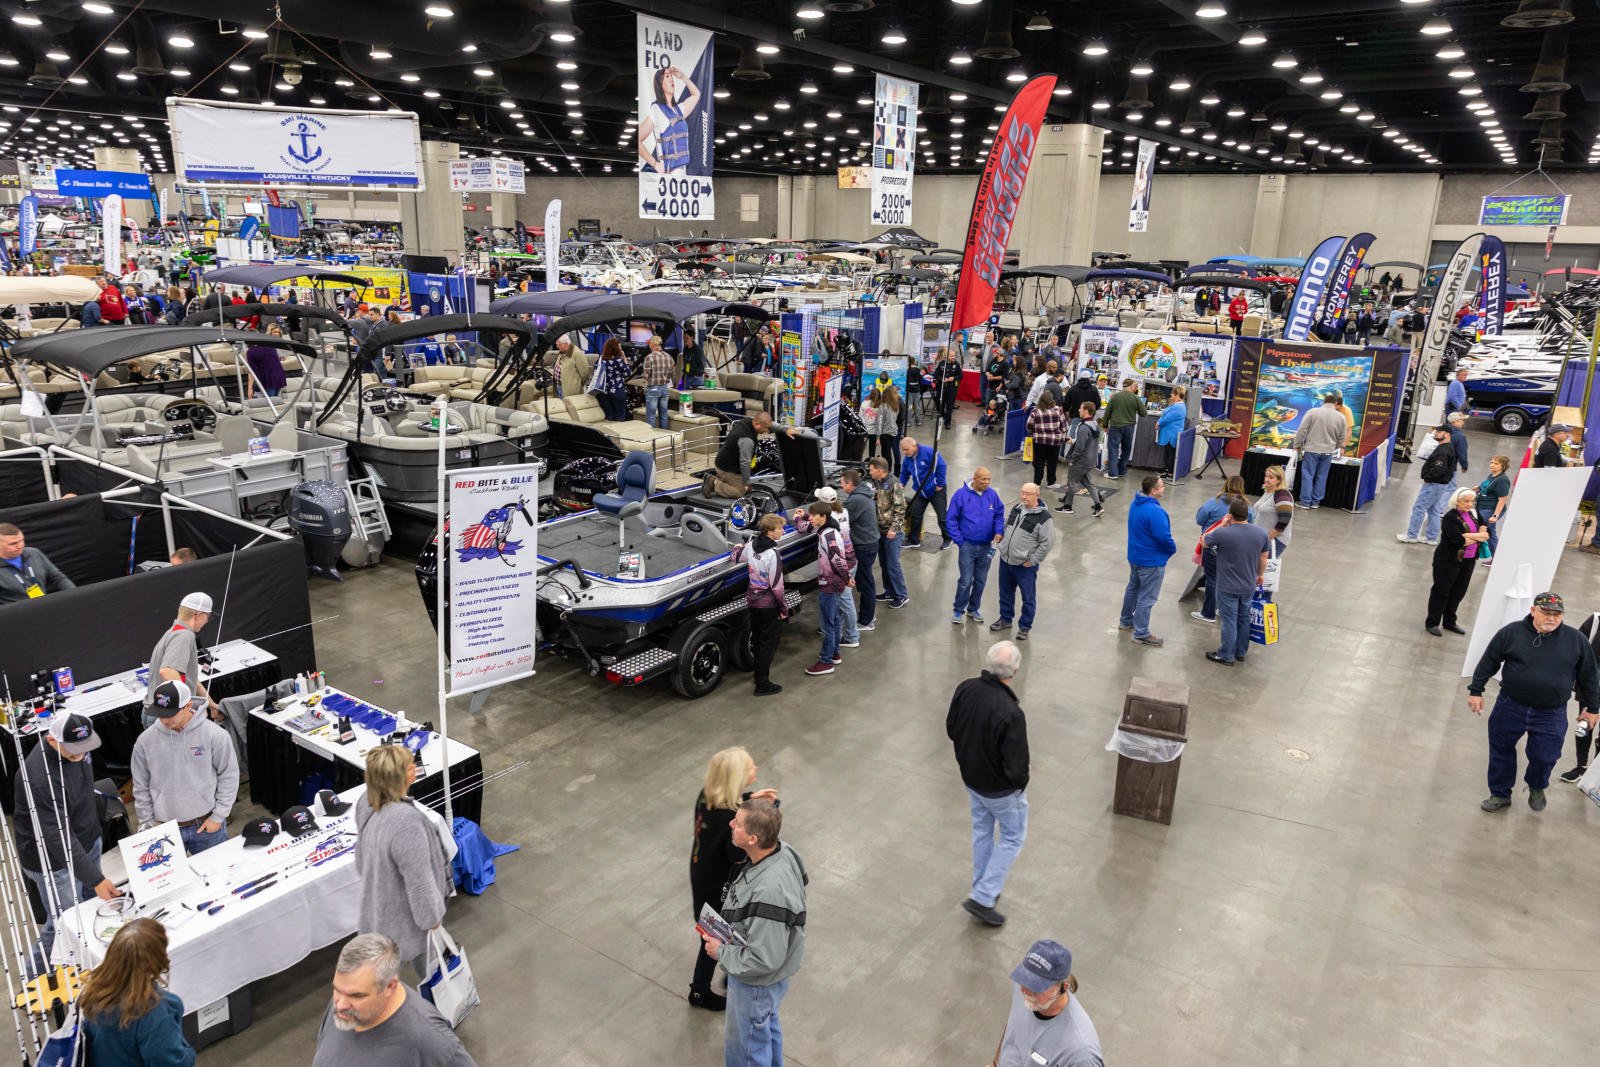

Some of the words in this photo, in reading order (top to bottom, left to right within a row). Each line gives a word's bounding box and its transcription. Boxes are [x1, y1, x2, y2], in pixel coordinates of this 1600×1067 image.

[645, 27, 683, 51] LAND
[645, 50, 671, 69] FLO
[280, 116, 294, 126] SMI
[296, 115, 327, 130] MARINE
[992, 135, 1003, 155] Put
[988, 157, 996, 168] In
[263, 173, 309, 181] LOUISVILLE,
[980, 171, 992, 196] With
[658, 177, 700, 198] 3000
[658, 198, 699, 218] 4000
[881, 193, 905, 209] 2000
[975, 200, 984, 218] The
[881, 209, 904, 224] 3000
[1323, 245, 1358, 327] MONTEREY
[1287, 256, 1330, 340] MANO
[1266, 348, 1312, 358] Pipestone
[1280, 358, 1312, 368] Fly-In
[454, 480, 475, 489] RED
[478, 478, 499, 487] BITE
[510, 475, 533, 484] BLUE
[304, 513, 324, 521] YAMAHA
[459, 588, 488, 596] PRECISION
[489, 583, 519, 591] BALANCED
[458, 599, 482, 607] QUALITY
[483, 593, 520, 603] COMPONENTS
[459, 616, 502, 627] PERSONALIZED
[456, 644, 531, 663] www.redbiteblue.com
[267, 843, 288, 855] RED
[326, 816, 349, 828] BLUE
